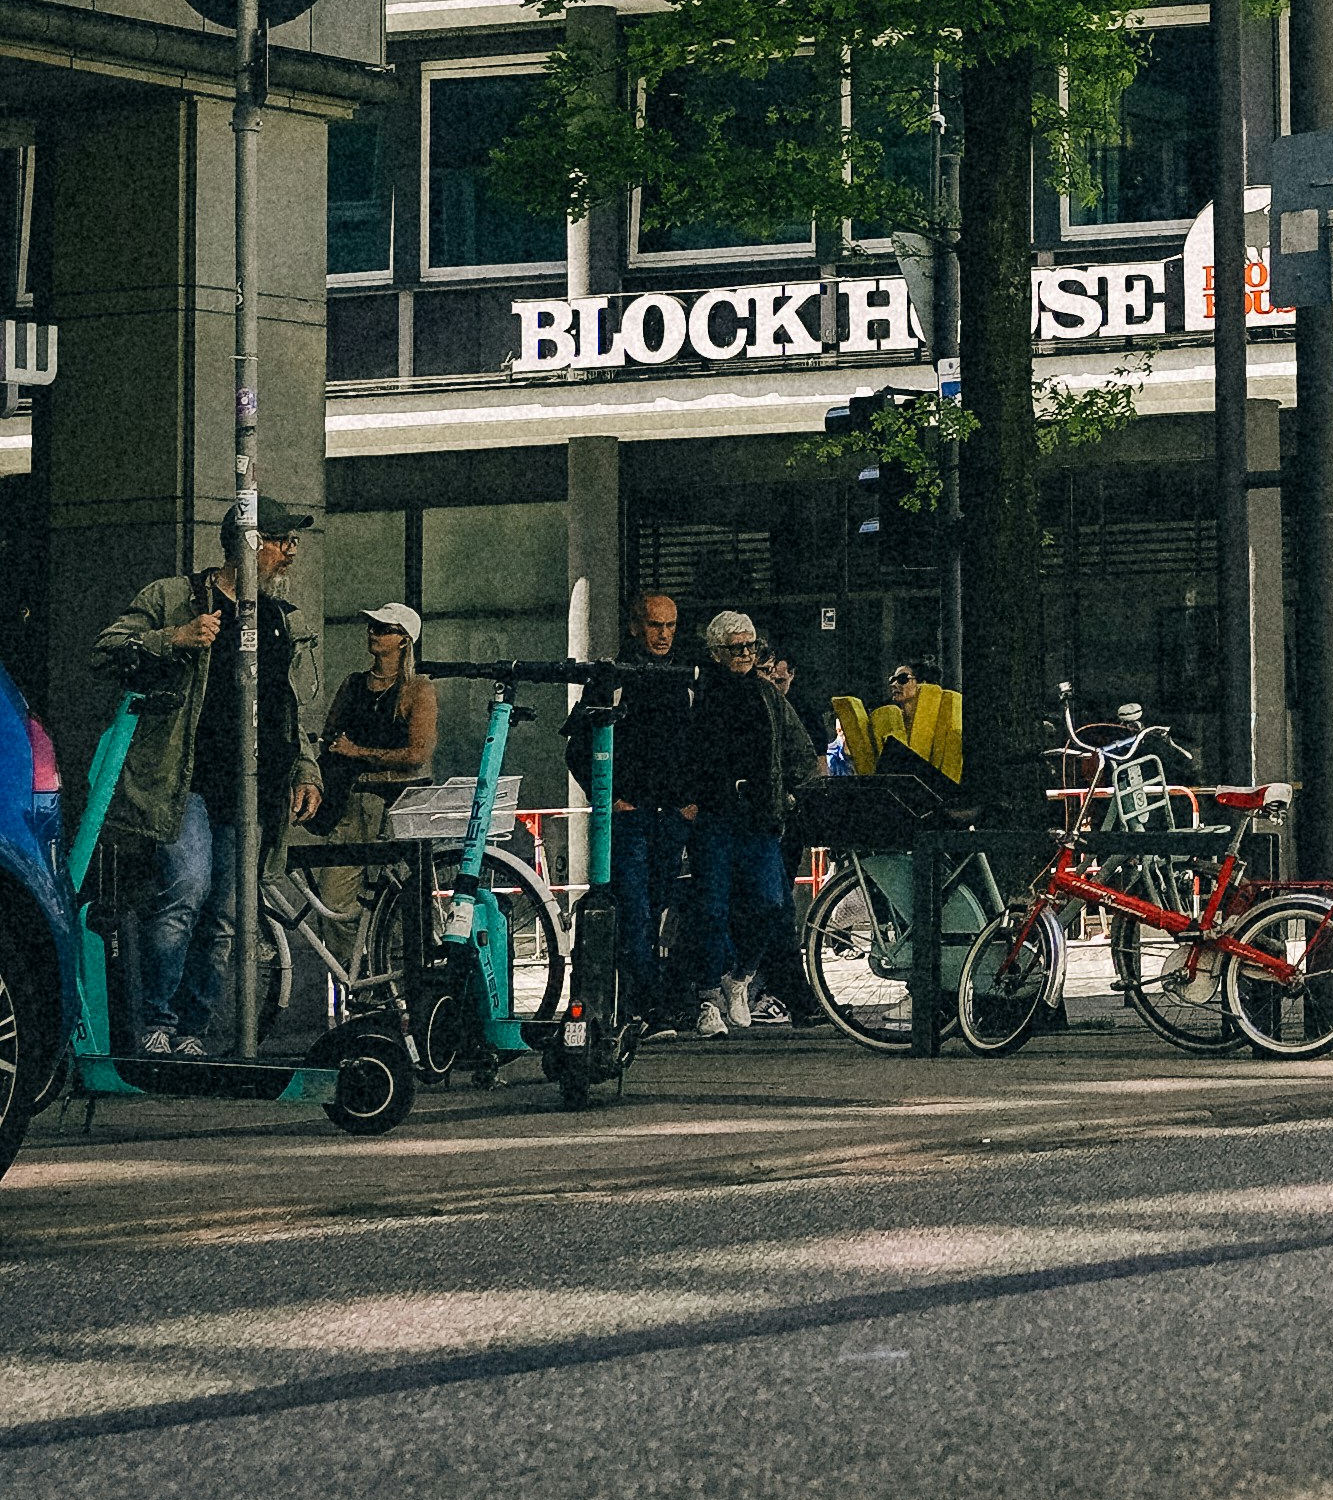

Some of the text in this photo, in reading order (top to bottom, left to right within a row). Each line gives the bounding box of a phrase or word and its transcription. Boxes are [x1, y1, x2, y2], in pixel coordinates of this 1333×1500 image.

[511, 259, 1166, 373] BLOCK HSE
[484, 957, 501, 1011] TIER
